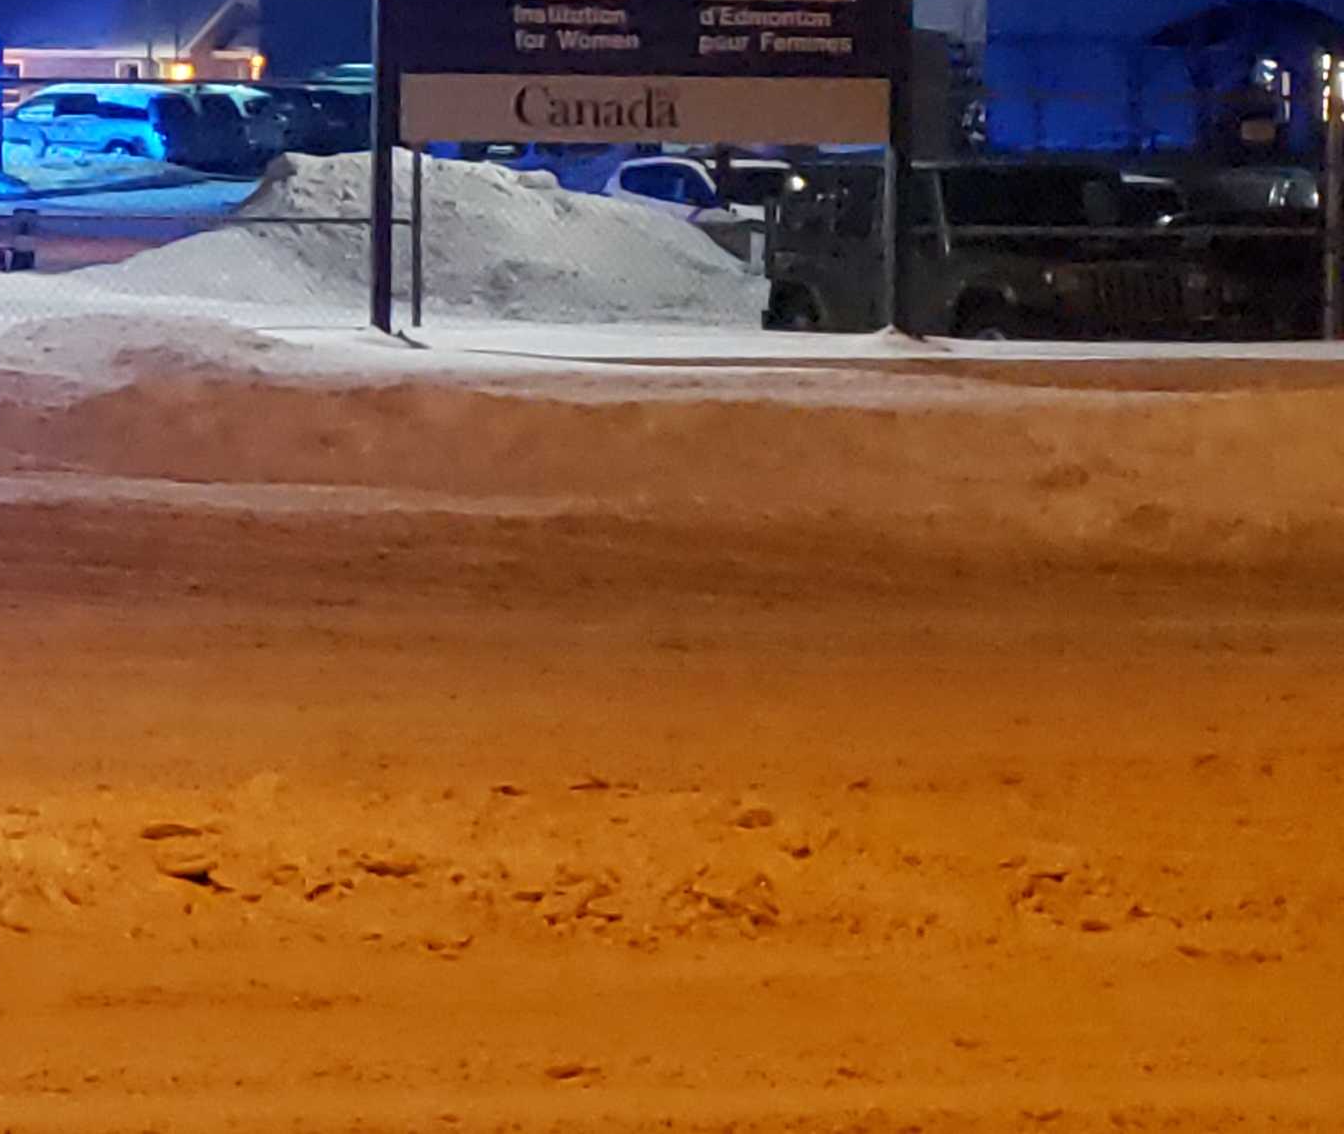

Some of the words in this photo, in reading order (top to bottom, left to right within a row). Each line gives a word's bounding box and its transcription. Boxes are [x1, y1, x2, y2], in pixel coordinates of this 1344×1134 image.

[514, 5, 626, 24] Institution
[700, 7, 832, 27] d'Edmonton
[515, 29, 545, 50] for
[557, 29, 640, 50] Women
[699, 35, 750, 55] pour
[760, 32, 852, 53] Femmes
[515, 82, 680, 128] Canada
